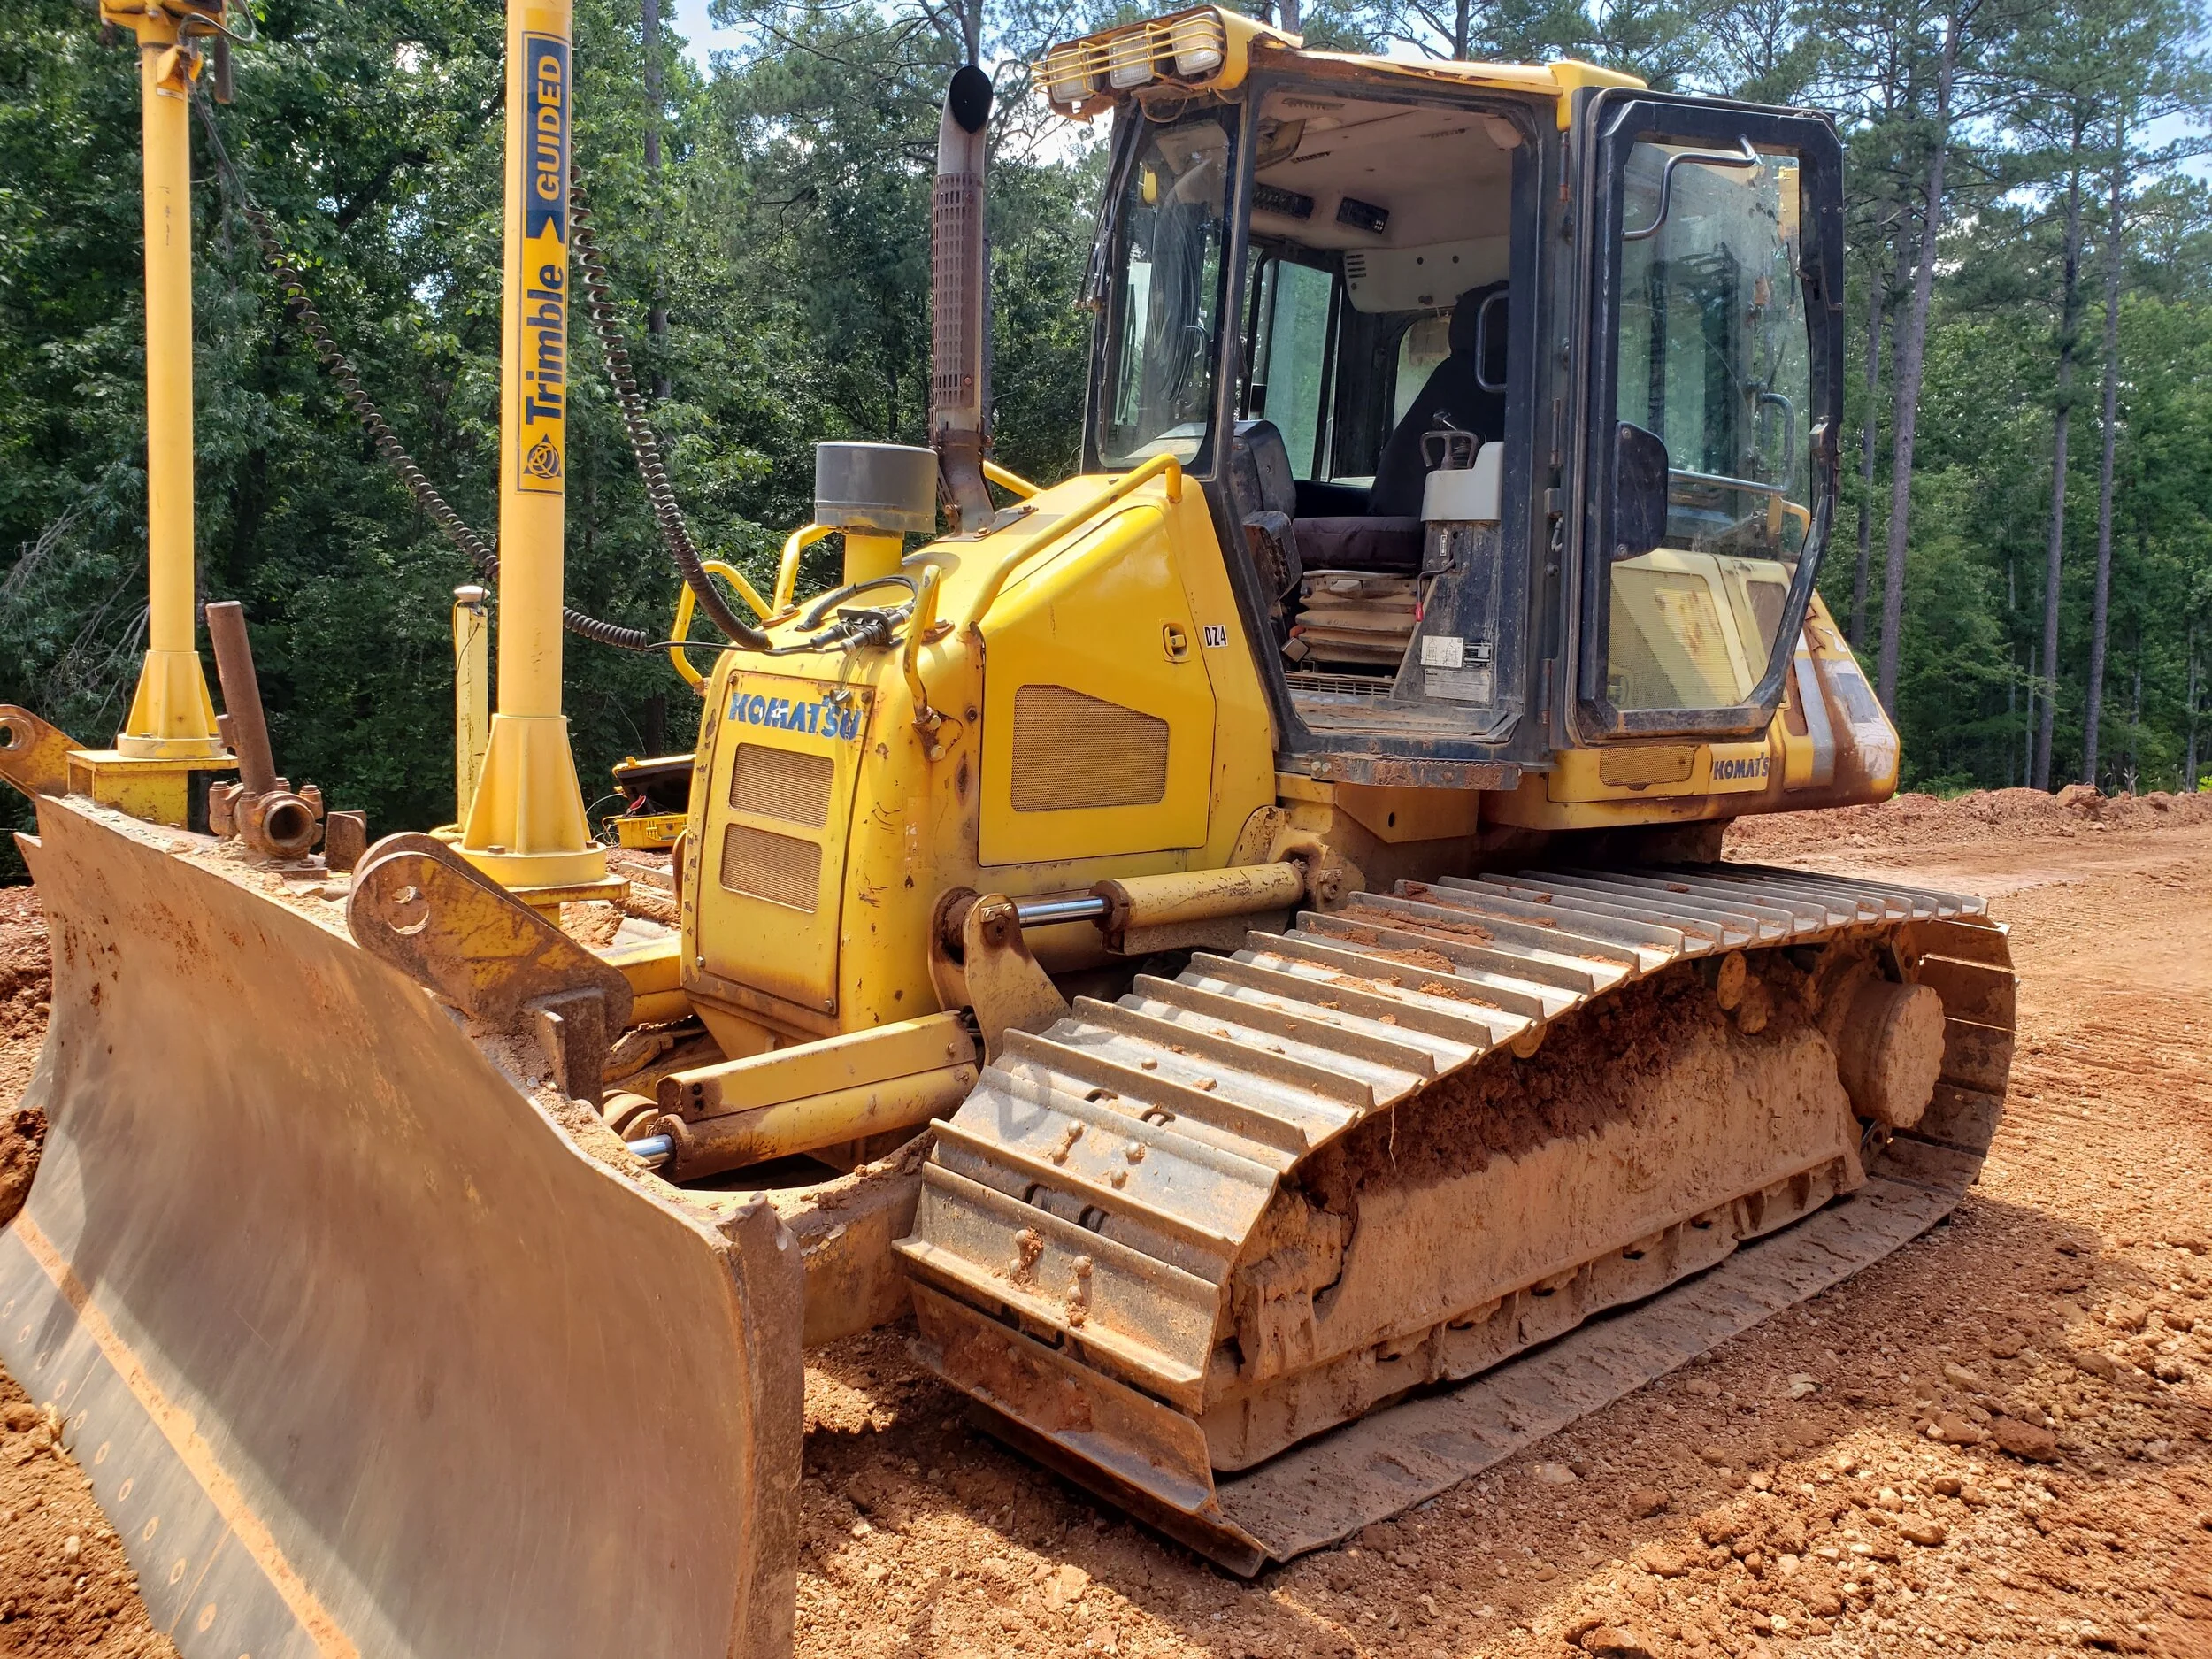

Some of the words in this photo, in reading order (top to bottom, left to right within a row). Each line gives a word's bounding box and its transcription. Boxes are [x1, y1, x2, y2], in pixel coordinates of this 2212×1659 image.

[536, 55, 561, 201] GUIDED
[526, 264, 564, 425] Trimble
[1204, 626, 1227, 647] DZ4
[728, 692, 863, 741] KOMATSU
